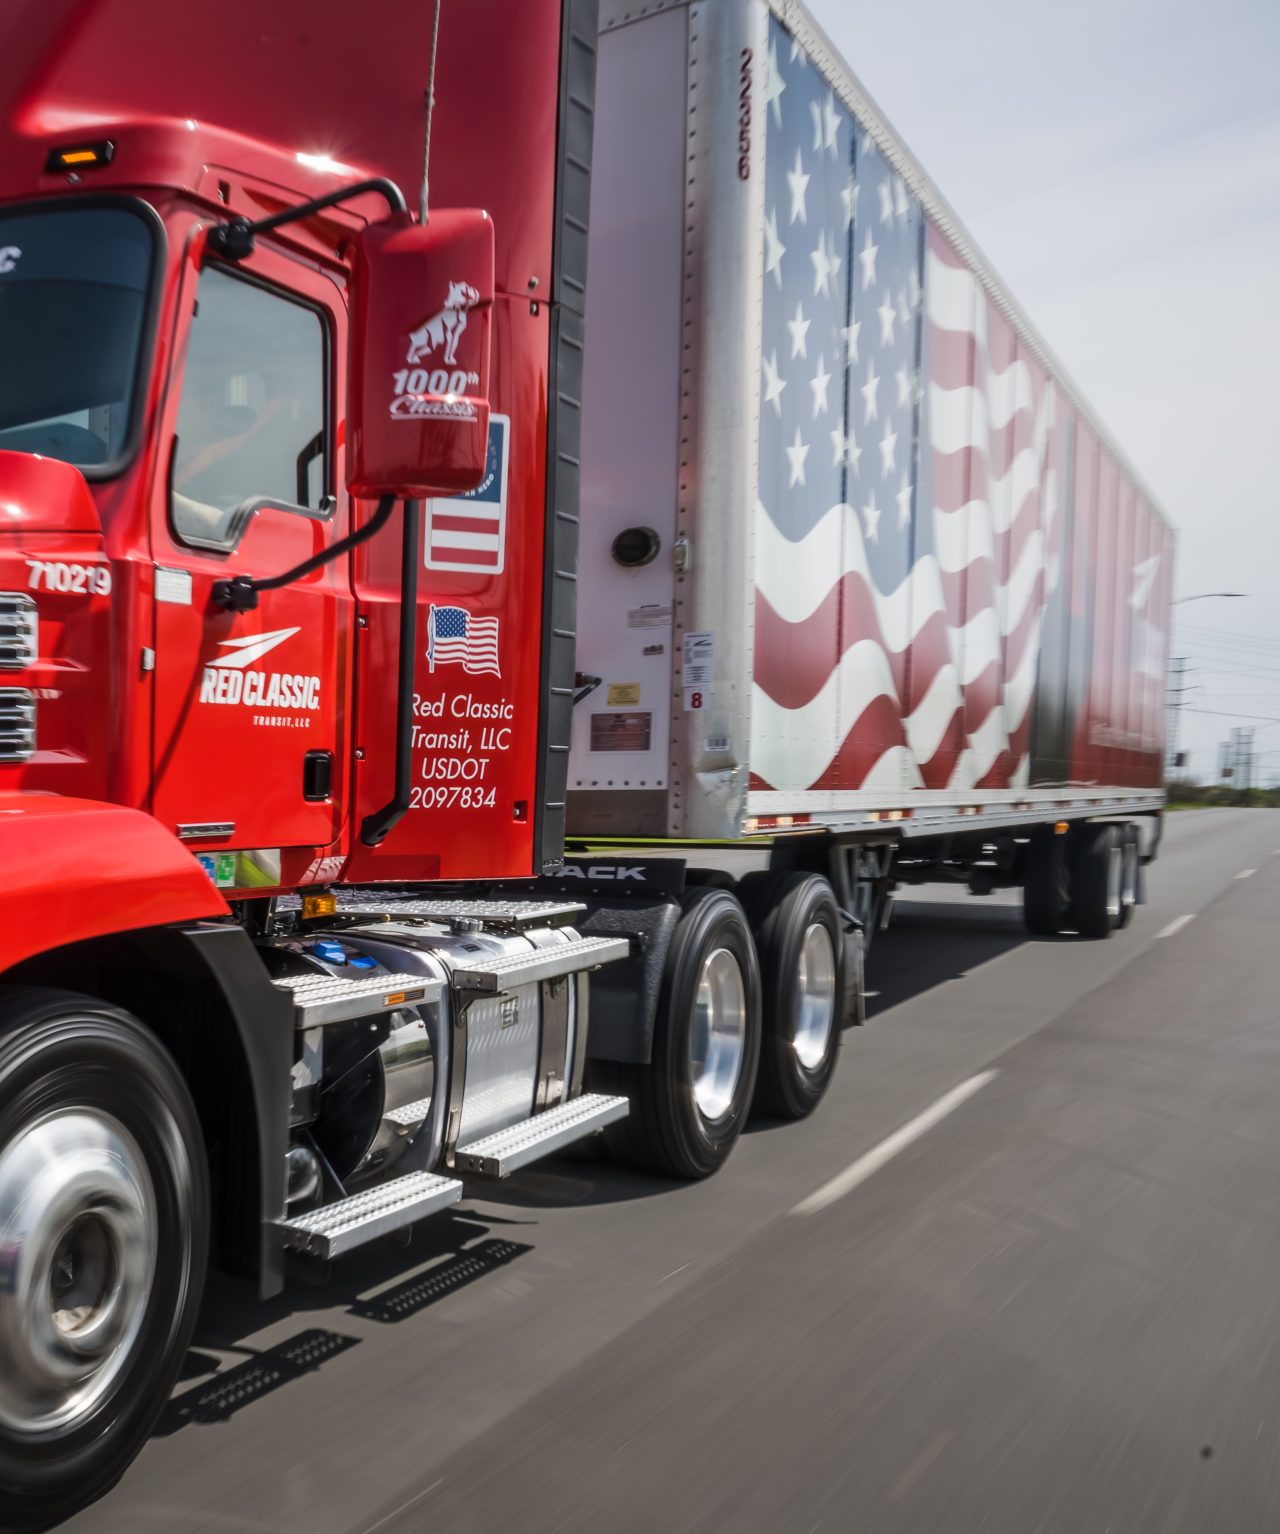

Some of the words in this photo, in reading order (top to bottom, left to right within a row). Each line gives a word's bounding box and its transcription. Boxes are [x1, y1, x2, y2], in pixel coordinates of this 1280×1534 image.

[25, 559, 112, 596] 710219
[412, 692, 446, 717] Red
[451, 693, 514, 719] Classic
[691, 692, 703, 709] 8
[411, 725, 473, 754] Transit,
[480, 727, 512, 750] LLC
[421, 757, 490, 780] USDOT
[408, 786, 497, 808] 2097834
[544, 865, 647, 881] ACK
